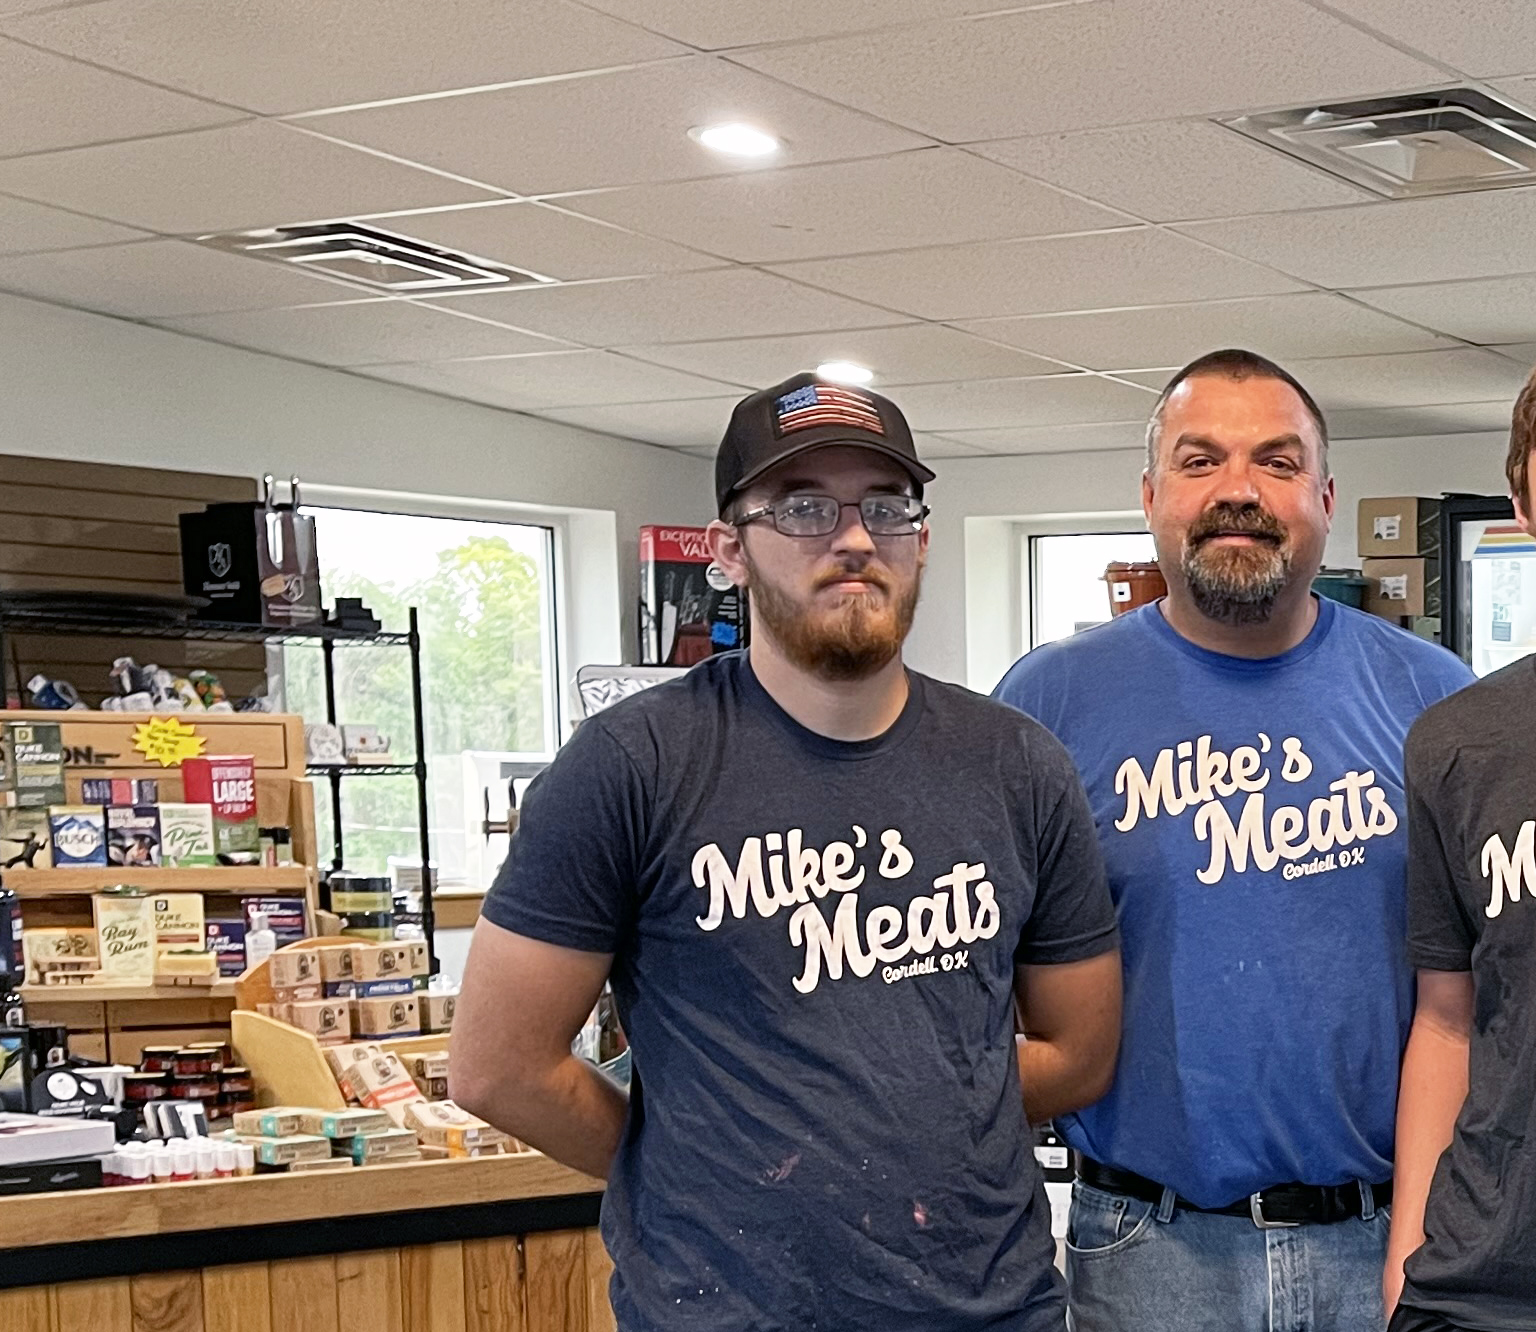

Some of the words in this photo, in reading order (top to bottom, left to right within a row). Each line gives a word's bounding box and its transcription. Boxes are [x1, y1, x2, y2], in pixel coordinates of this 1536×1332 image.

[680, 541, 710, 557] VAL
[213, 780, 255, 803] LARGE
[1114, 732, 1313, 833] Mike's
[1193, 770, 1398, 885] Meats
[691, 825, 914, 931] Mike's
[1282, 857, 1337, 881] Cordell
[1339, 847, 1365, 867] OK
[789, 862, 1000, 994] Meats
[107, 940, 148, 957] Rum
[882, 956, 938, 984] Cordell
[940, 950, 968, 972] OK
